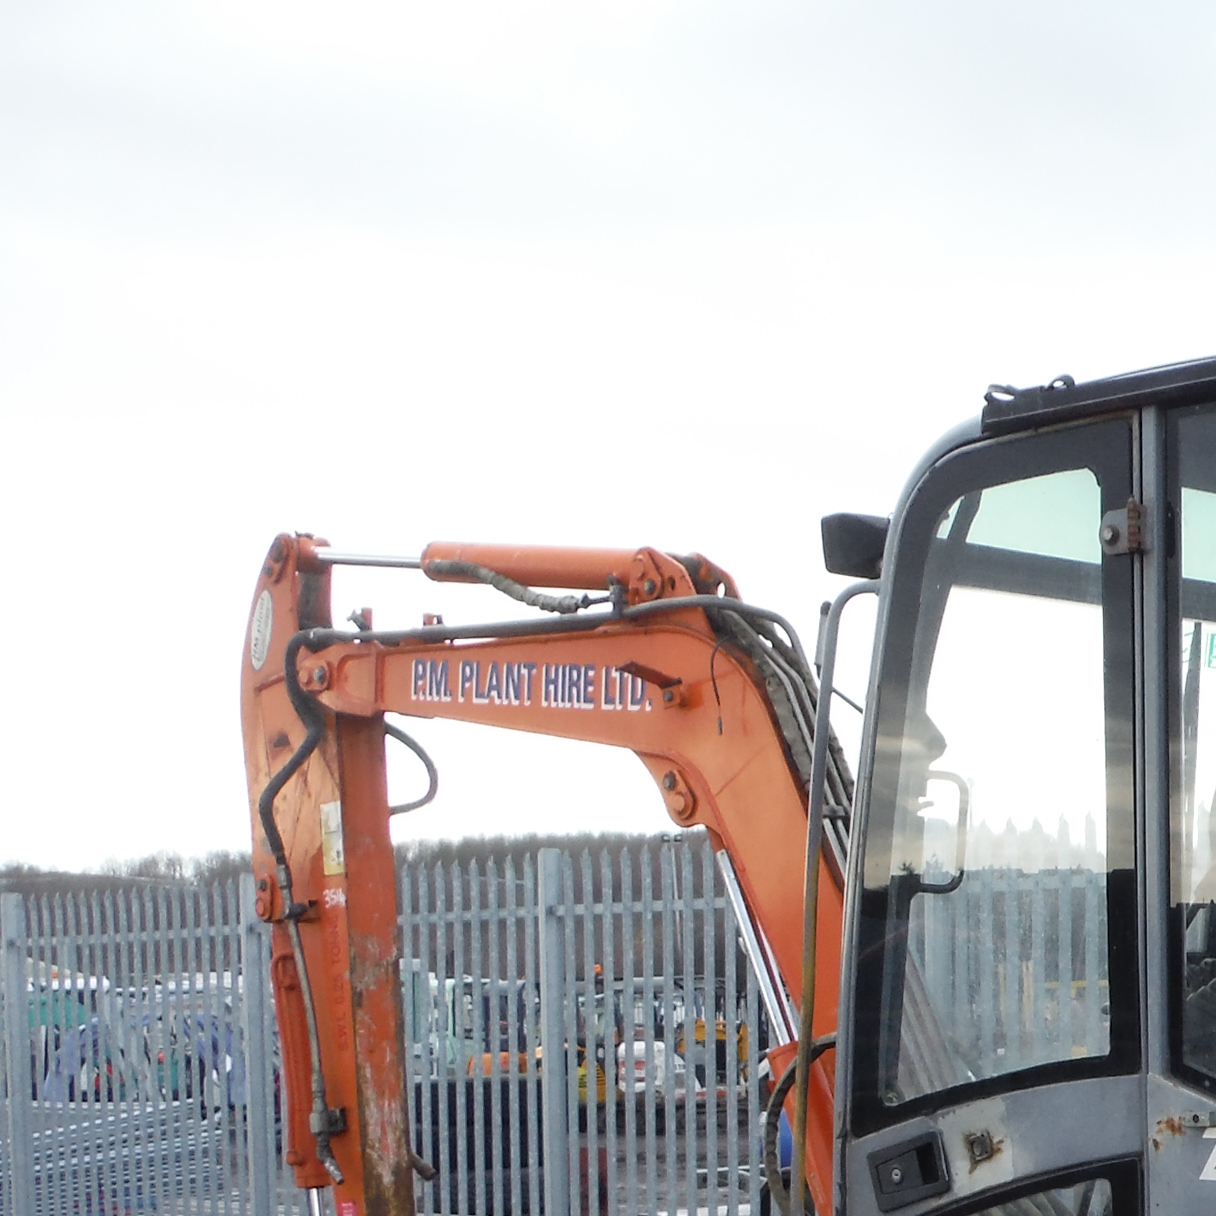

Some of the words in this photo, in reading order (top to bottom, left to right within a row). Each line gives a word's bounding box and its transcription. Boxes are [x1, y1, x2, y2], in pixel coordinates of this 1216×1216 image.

[411, 658, 452, 702] P.M.
[458, 660, 537, 706] PLANT
[541, 663, 596, 710] HIRE
